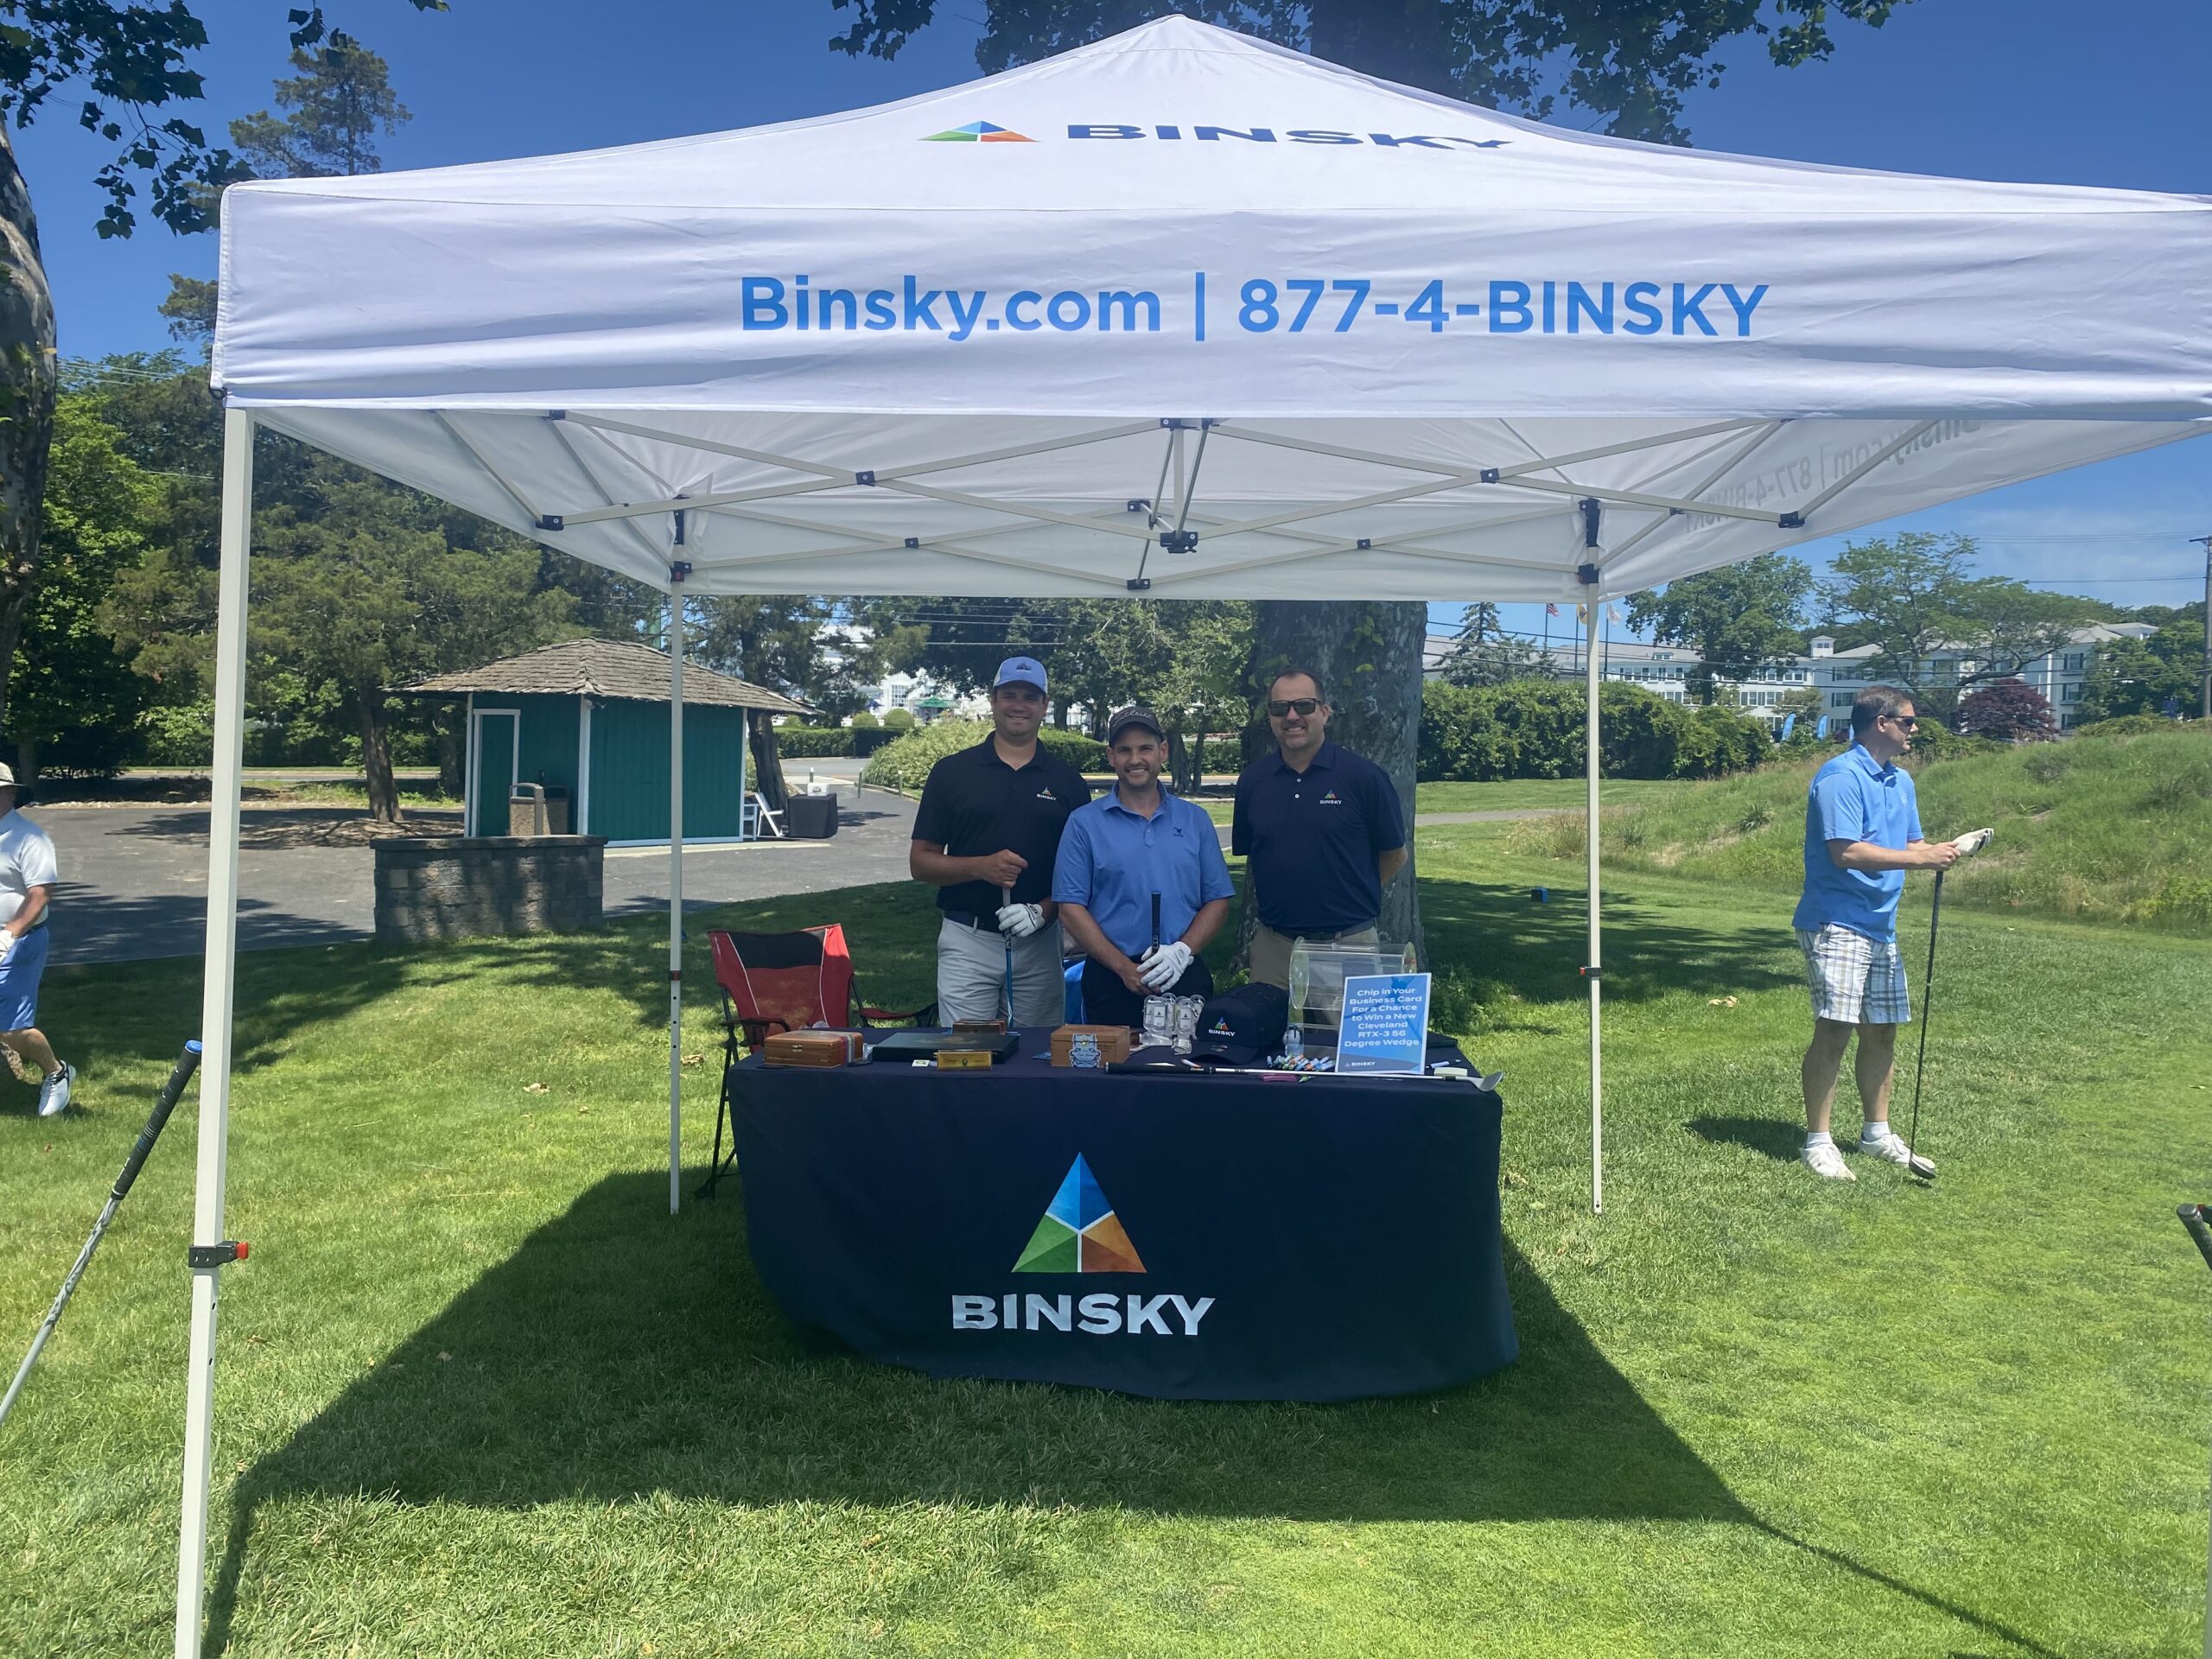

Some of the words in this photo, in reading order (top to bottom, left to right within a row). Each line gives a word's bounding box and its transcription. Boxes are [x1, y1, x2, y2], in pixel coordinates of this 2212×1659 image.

[1067, 124, 1514, 149] BINSKY
[741, 274, 1160, 341] Binsky.com
[1238, 278, 1770, 338] 877-4-BINSKY
[1357, 988, 1380, 997] Chip
[1357, 1021, 1408, 1030] Cleveland
[1208, 1028, 1236, 1037] BINSKY
[1382, 1039, 1420, 1047] Wedge
[952, 1294, 1216, 1336] BINSKY
